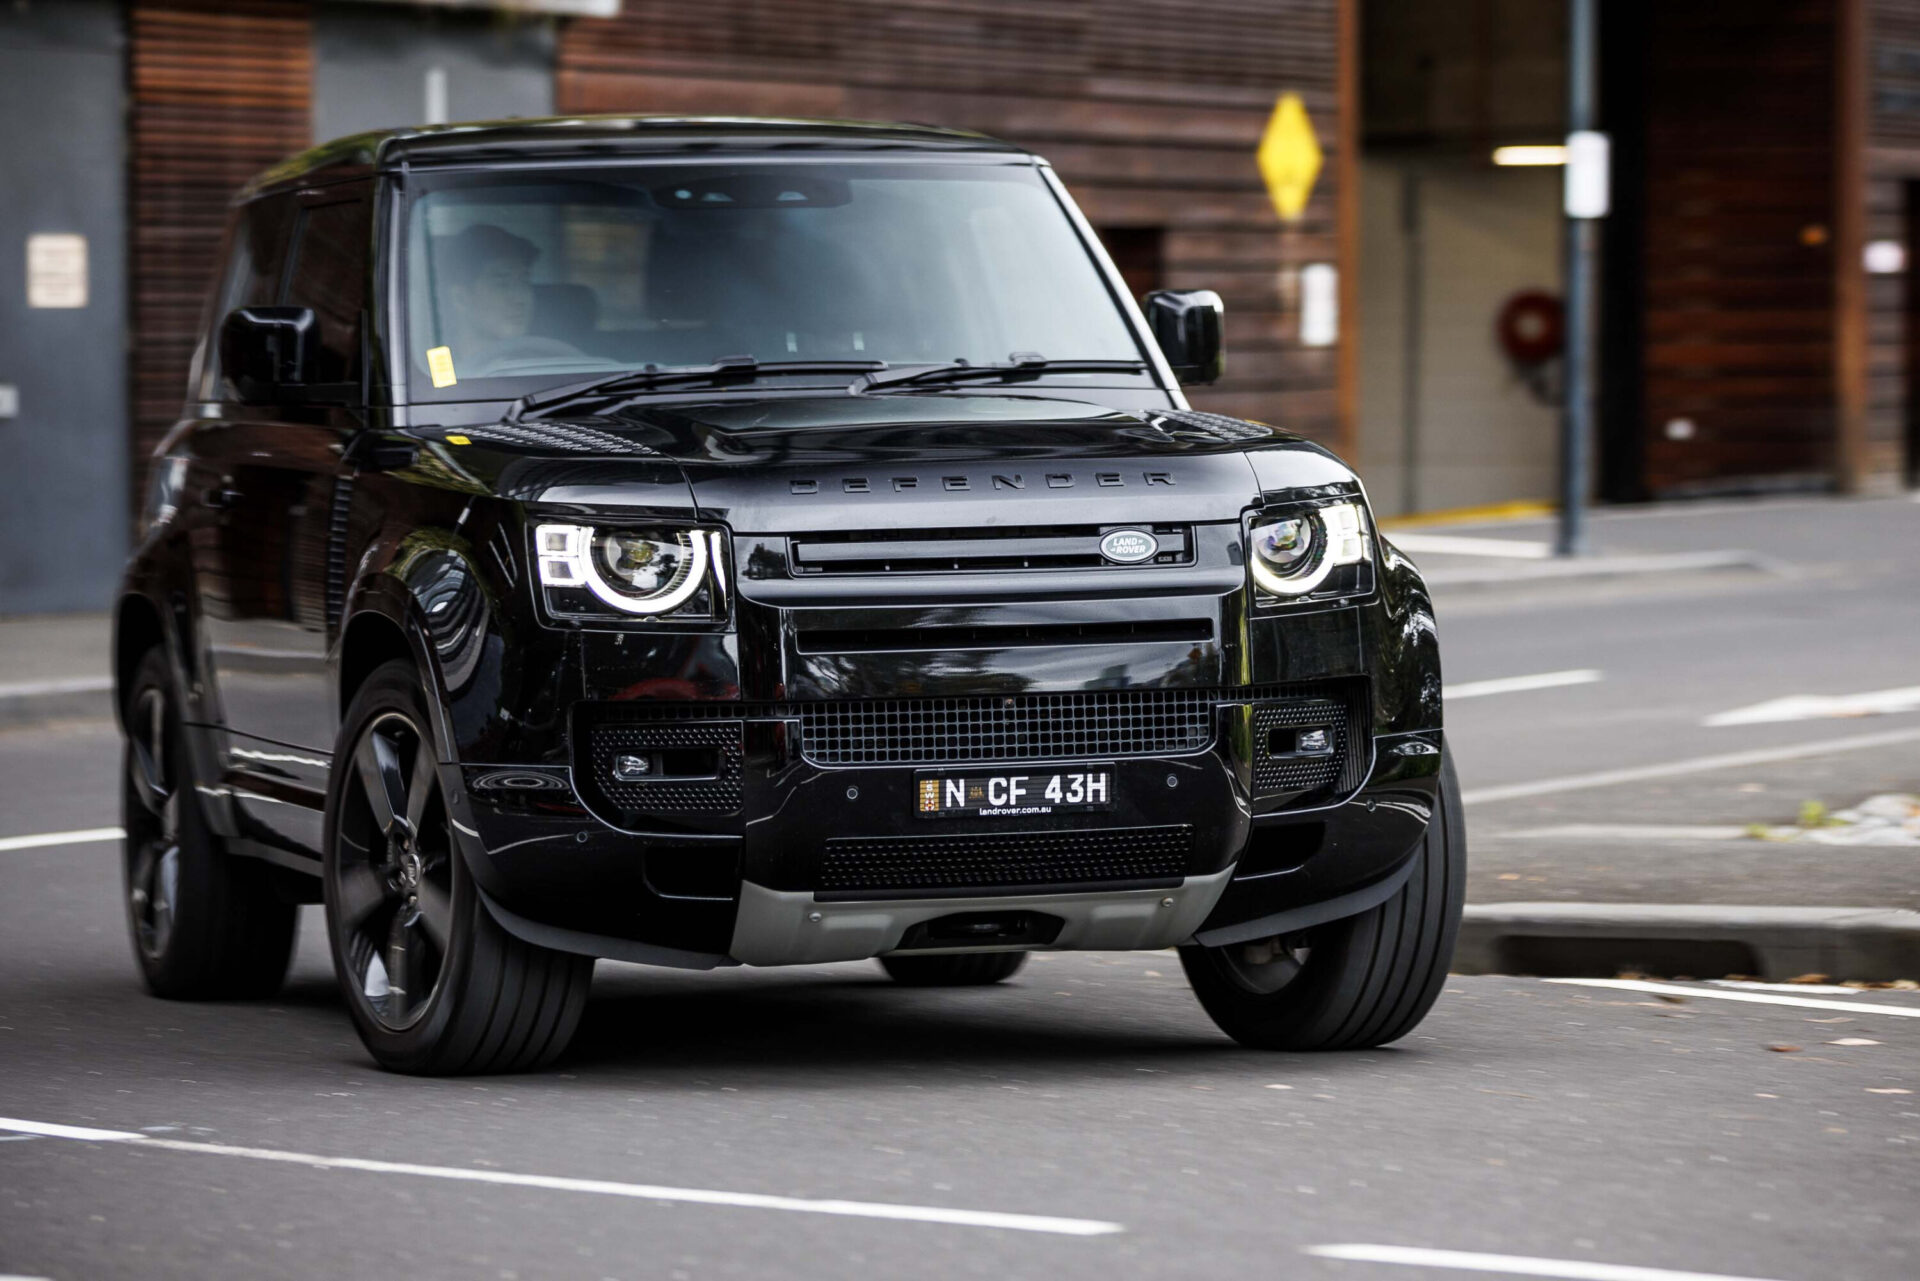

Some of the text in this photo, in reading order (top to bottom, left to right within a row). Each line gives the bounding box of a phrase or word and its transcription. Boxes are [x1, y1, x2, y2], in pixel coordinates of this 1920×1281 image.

[790, 472, 1176, 495] DEFENDER
[1112, 537, 1138, 546] LAND
[1116, 545, 1146, 554] ROVER
[946, 773, 1106, 807] N CF 43H
[979, 806, 1052, 816] landrover.com.au
